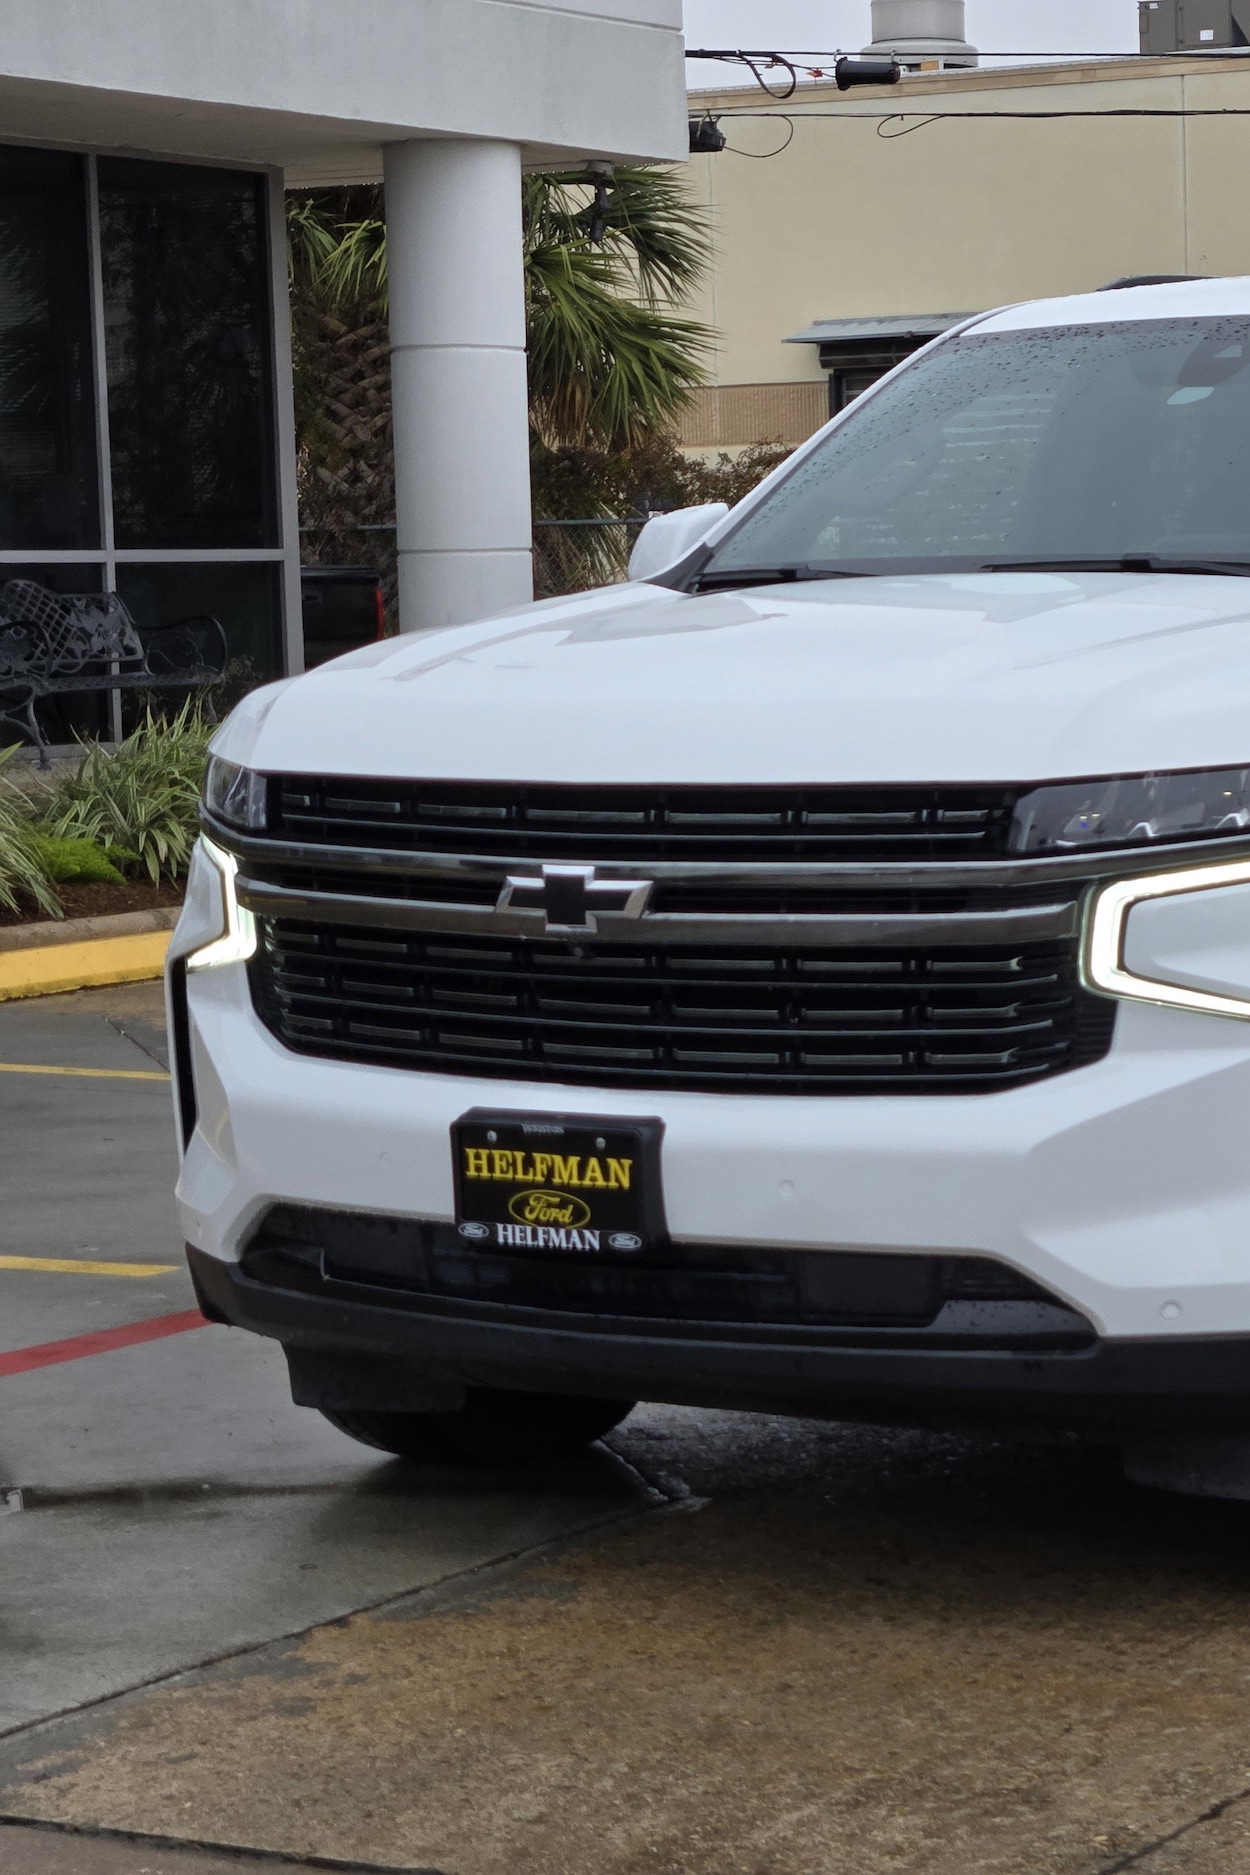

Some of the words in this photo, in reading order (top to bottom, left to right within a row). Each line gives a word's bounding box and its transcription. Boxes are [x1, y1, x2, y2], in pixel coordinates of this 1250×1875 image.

[464, 1148, 632, 1189] HELFMAN
[524, 1194, 573, 1223] Ford
[497, 1223, 600, 1250] HELFMAN
